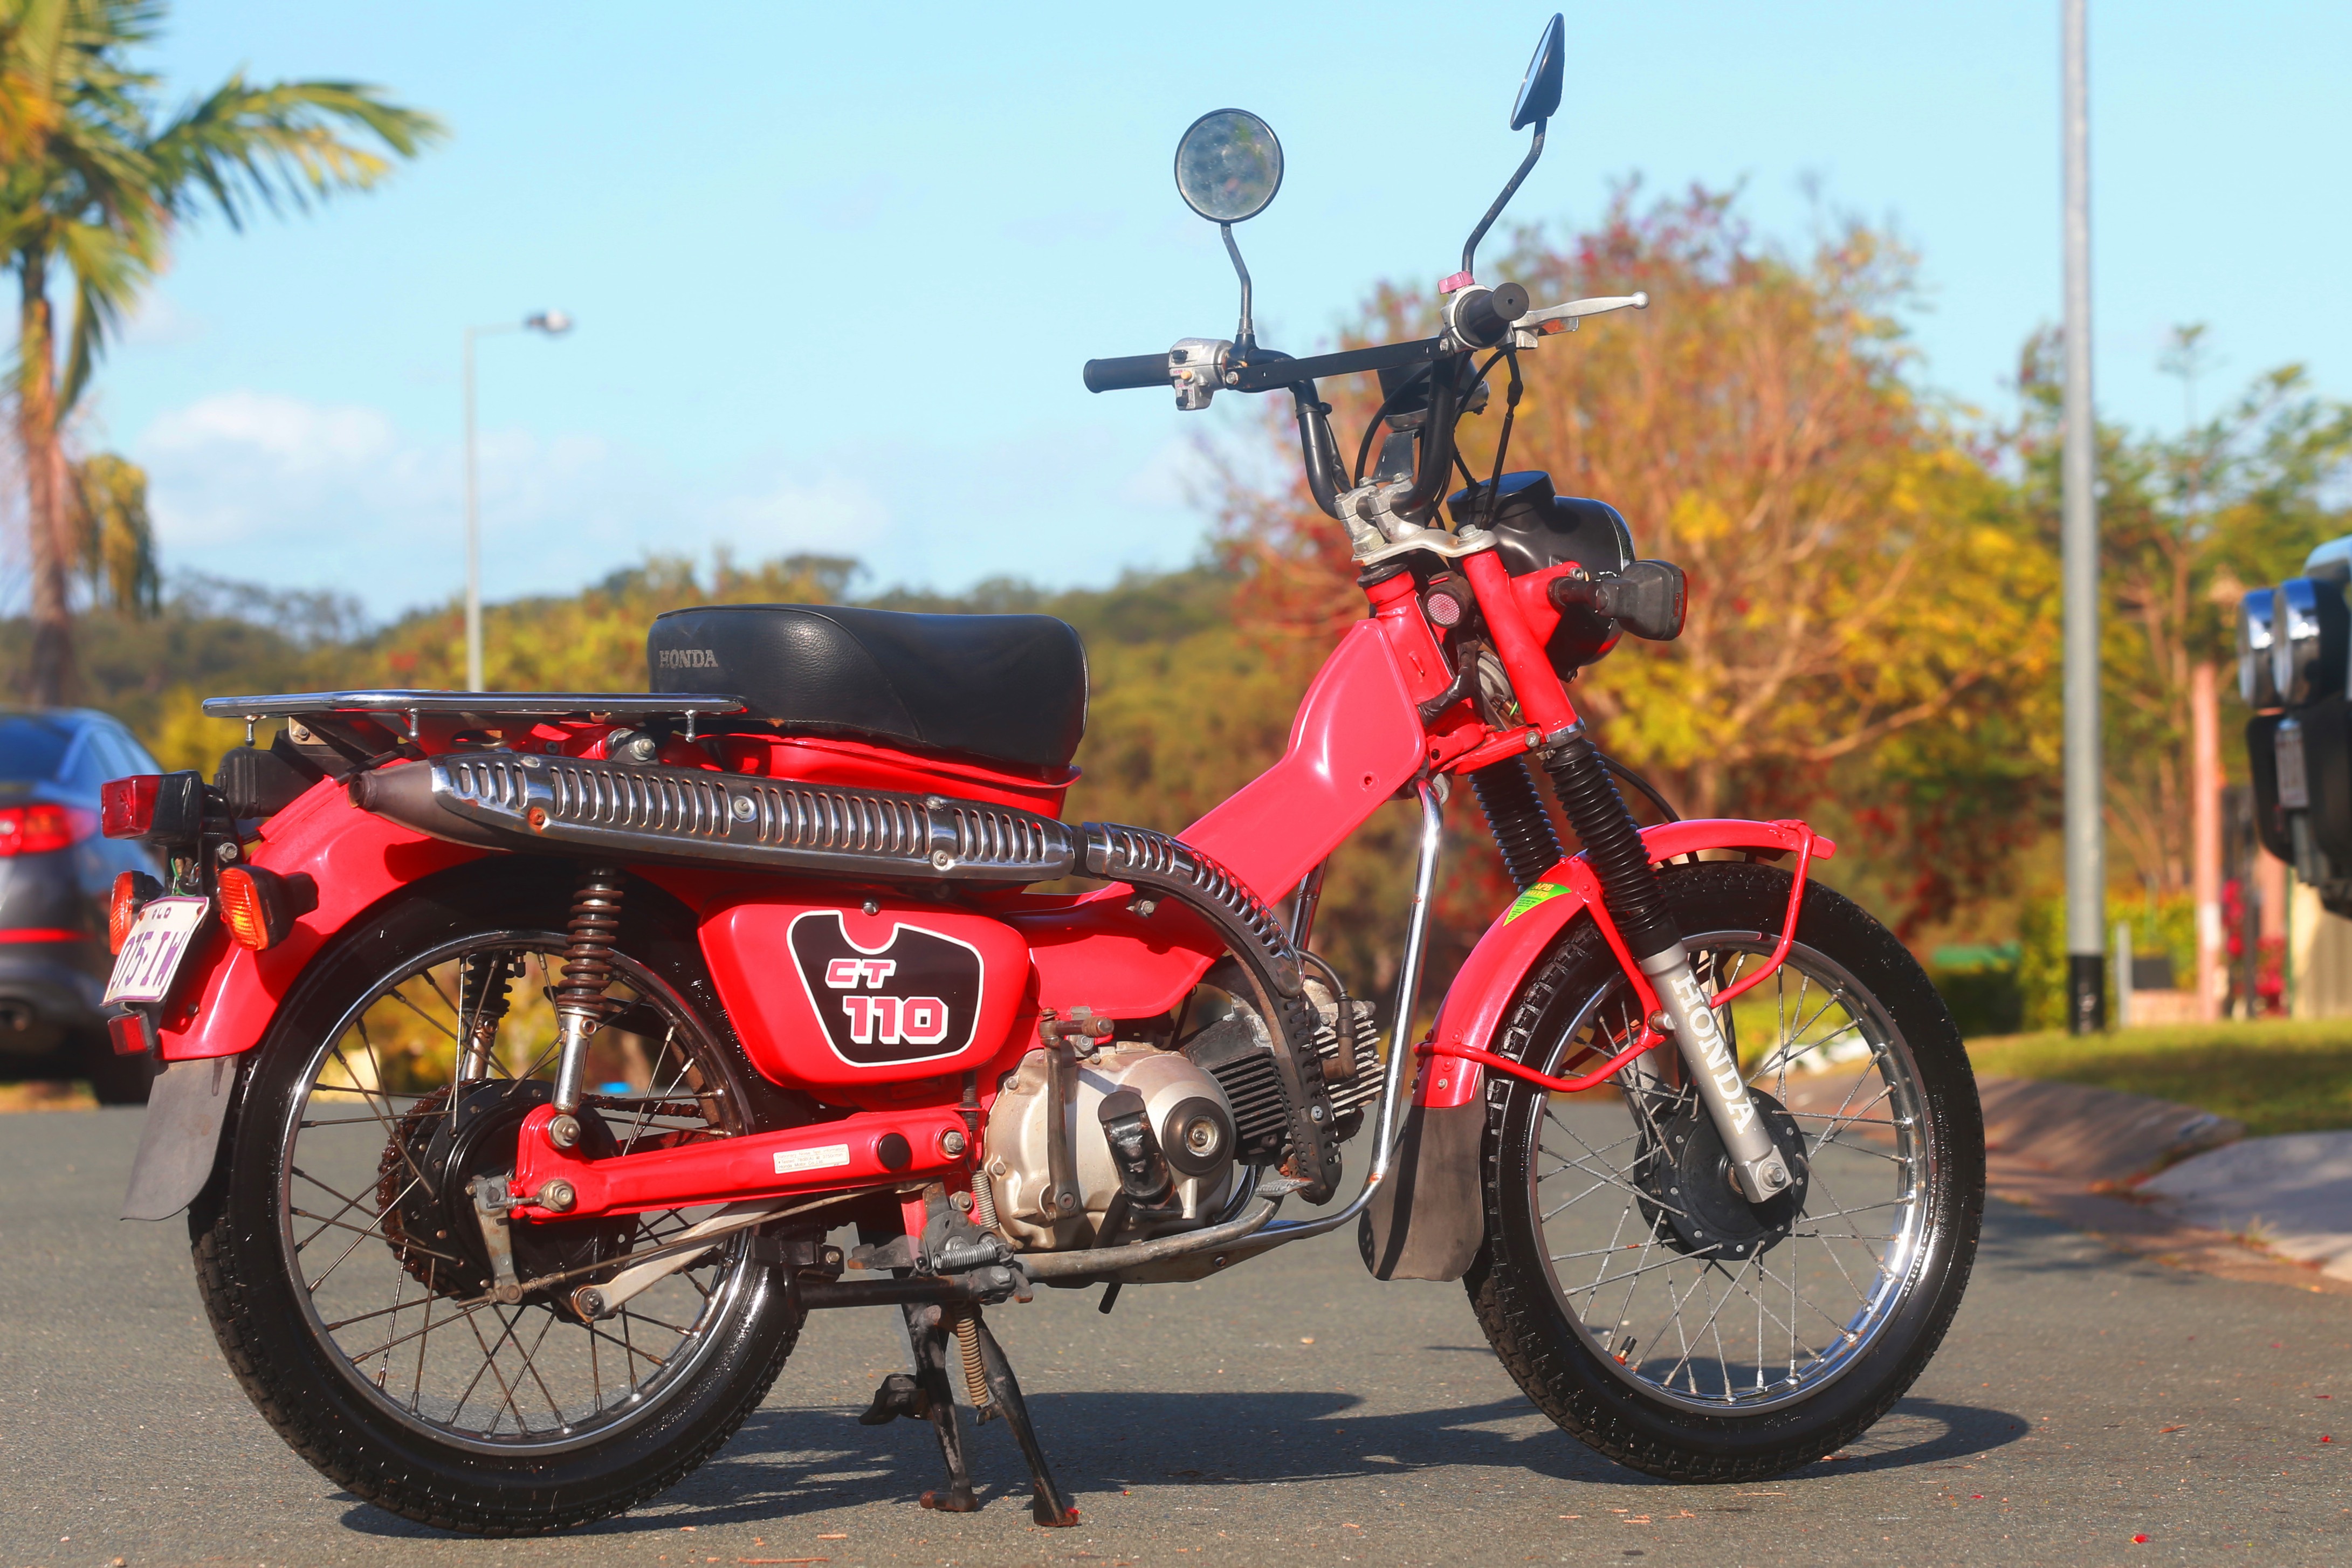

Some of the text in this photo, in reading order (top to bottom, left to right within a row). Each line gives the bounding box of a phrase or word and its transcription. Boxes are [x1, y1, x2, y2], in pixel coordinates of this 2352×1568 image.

[659, 649, 718, 669] HONDA
[1532, 883, 1554, 891] APB
[825, 959, 896, 988] CT
[843, 995, 948, 1044] 110
[1672, 970, 1756, 1134] HONDA
